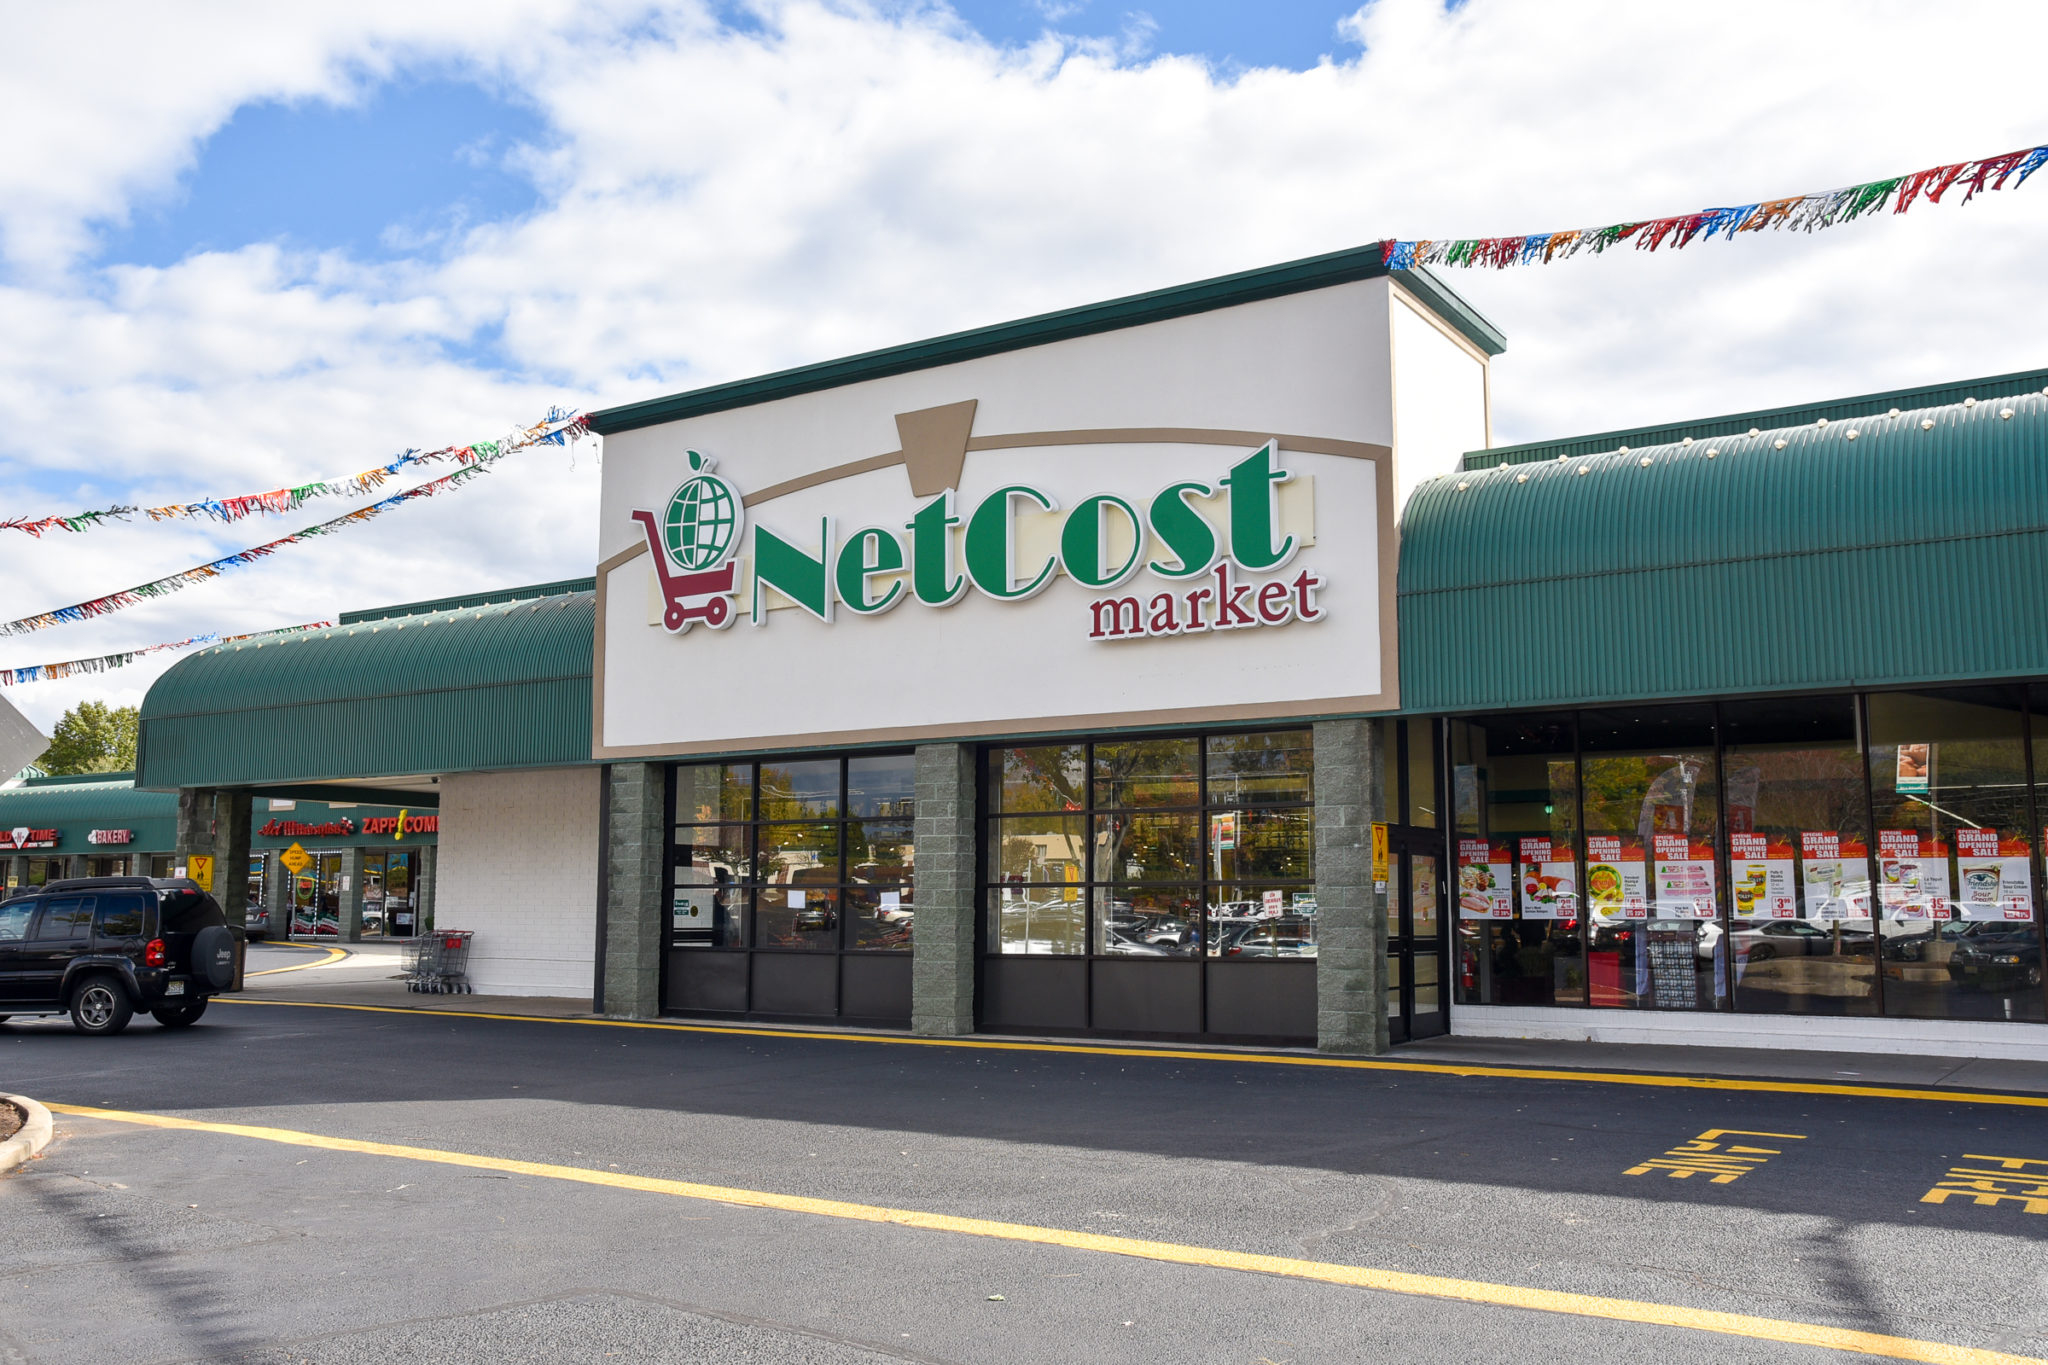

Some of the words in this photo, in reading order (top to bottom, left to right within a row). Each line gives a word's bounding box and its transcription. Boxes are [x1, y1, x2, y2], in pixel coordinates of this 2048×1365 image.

[753, 440, 1293, 626] NetCost
[1088, 562, 1327, 642] market
[31, 829, 57, 841] TIME
[97, 830, 128, 844] BAKERY
[1803, 836, 1839, 844] GRAND
[216, 948, 232, 960] Jeep
[1621, 1128, 1808, 1184] LANE
